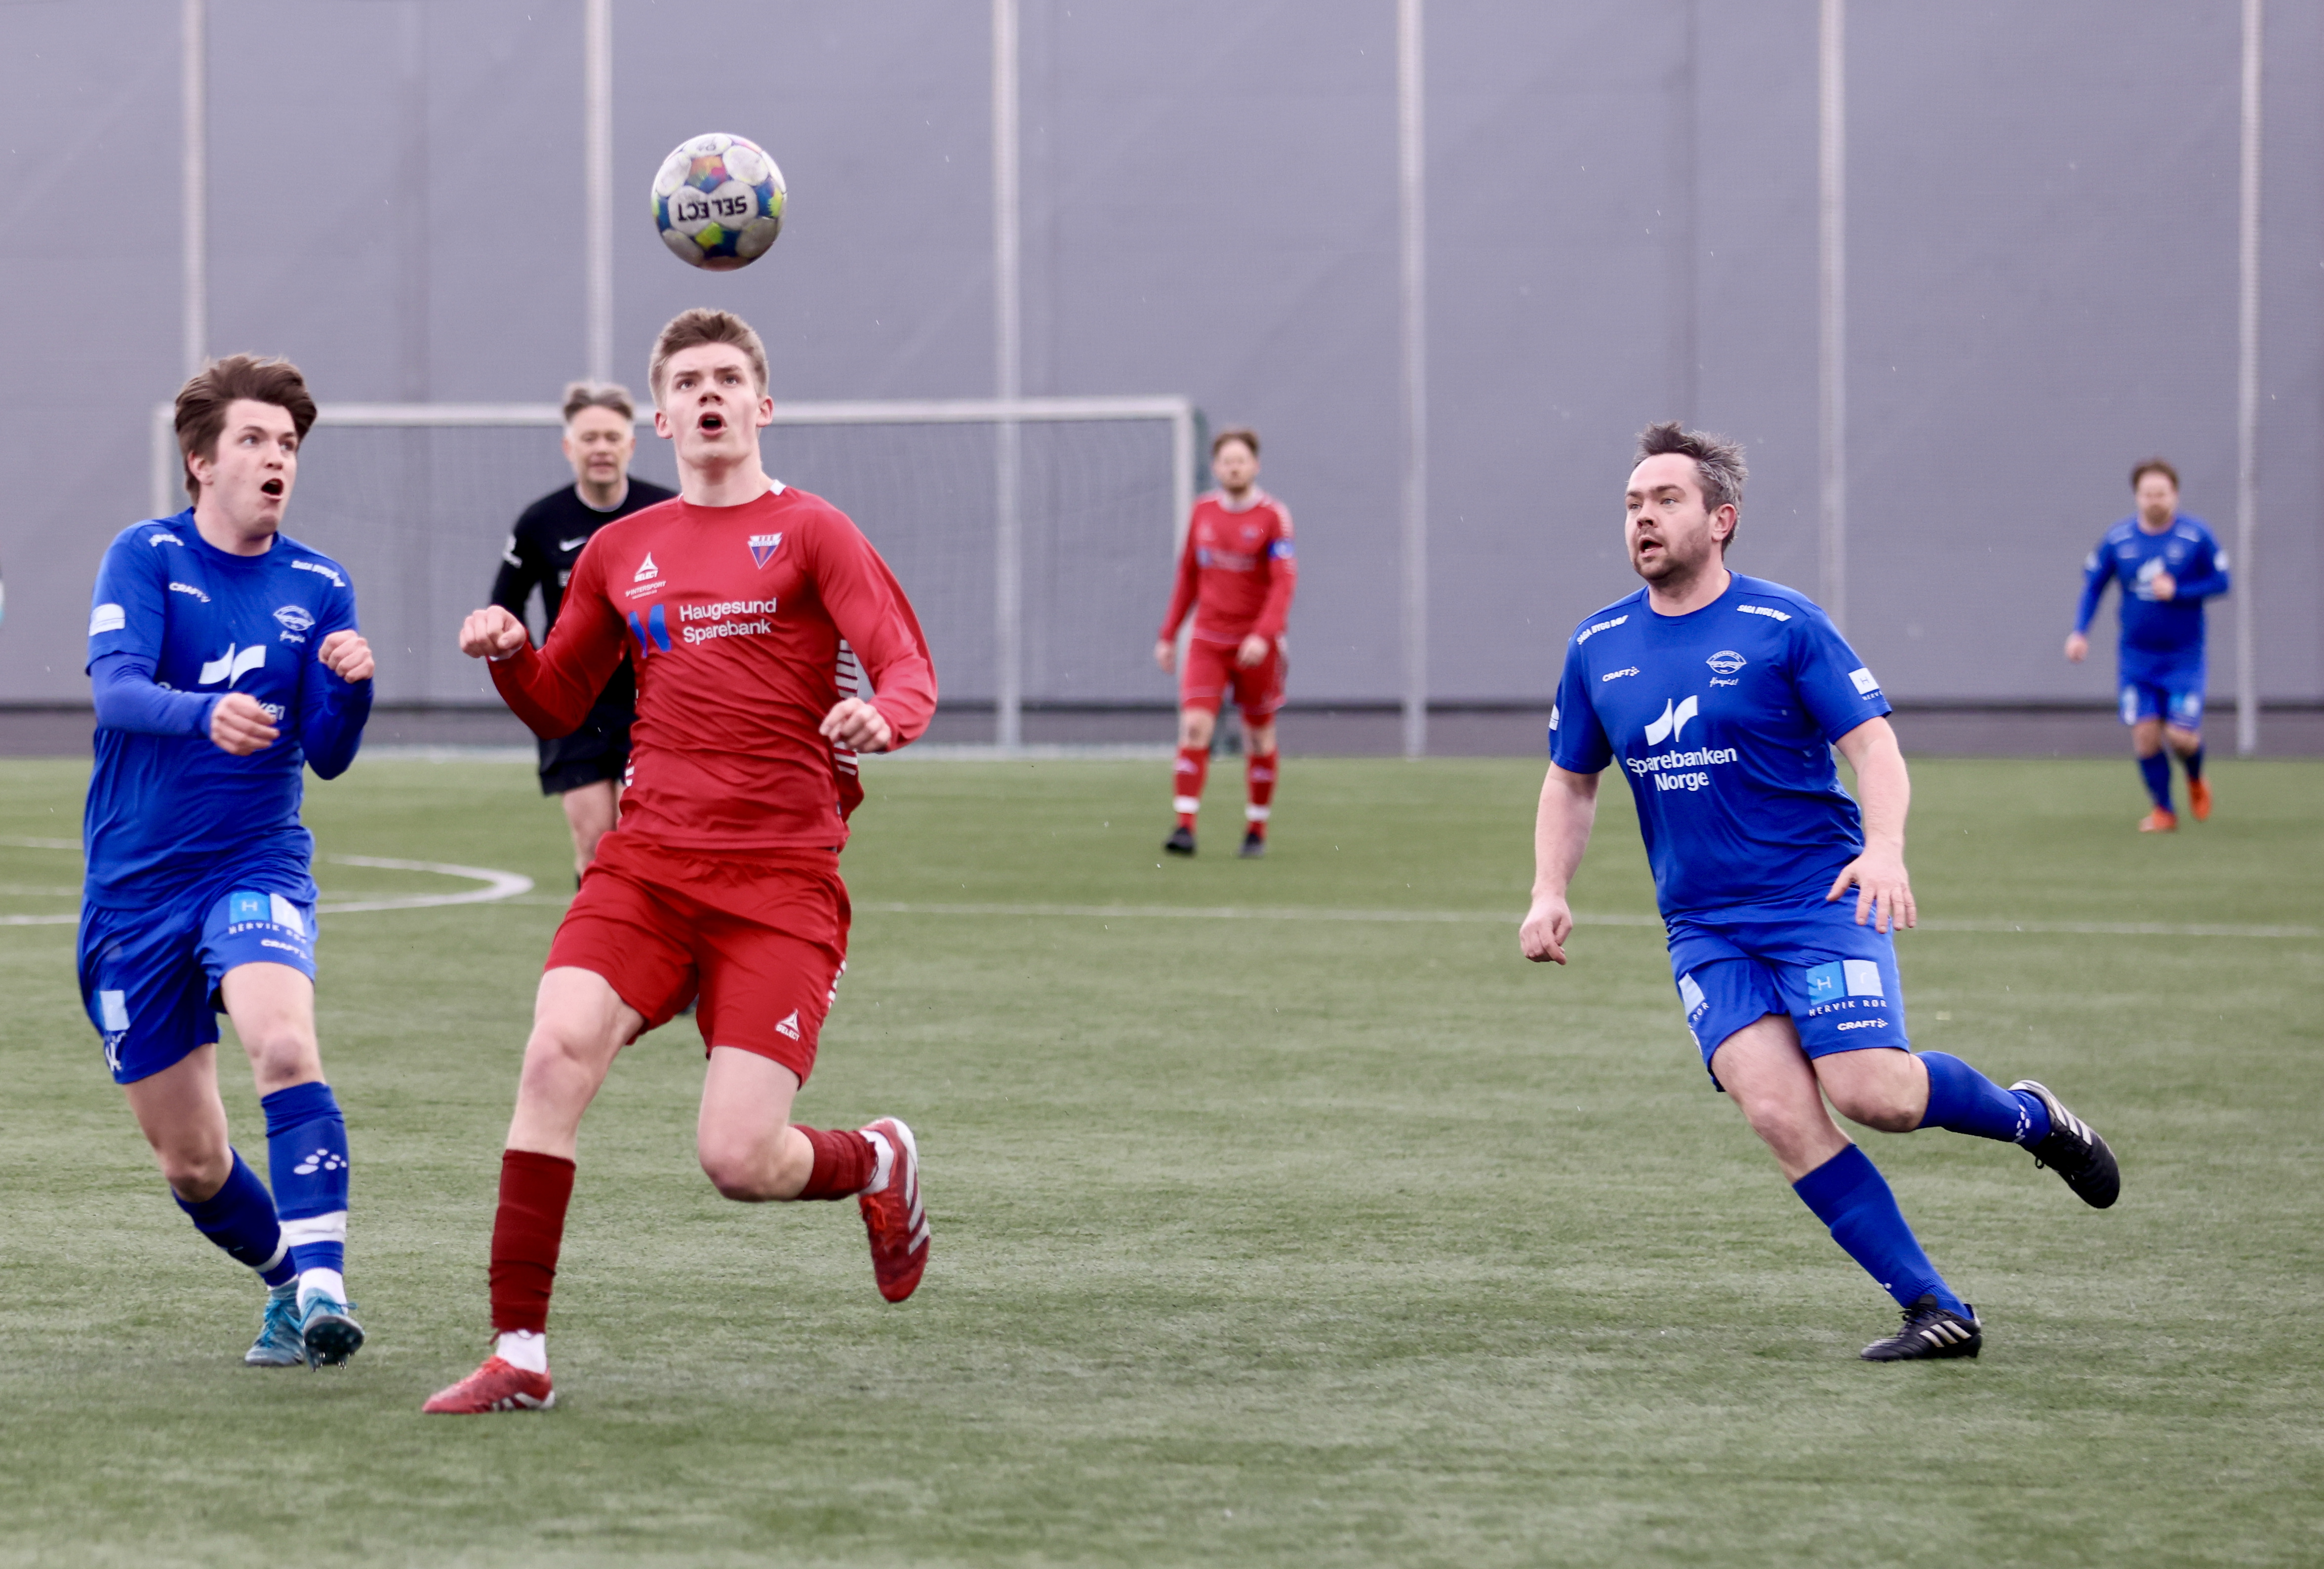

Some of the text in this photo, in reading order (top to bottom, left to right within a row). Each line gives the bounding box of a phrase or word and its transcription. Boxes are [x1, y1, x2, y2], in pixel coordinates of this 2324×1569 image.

[678, 196, 747, 221] SELECT
[634, 570, 658, 583] SELECT
[631, 581, 667, 595] INTERSPORT
[679, 597, 777, 622] Haugesund
[682, 618, 772, 646] Sparebank
[1577, 628, 1593, 645] SAGA
[1602, 668, 1631, 682] CRAFT
[1626, 746, 1738, 778] Sparebanken
[1653, 771, 1710, 791] Norge
[1817, 976, 1832, 991] H
[1808, 1000, 1856, 1017] HERVIK
[775, 1024, 801, 1042] SELECT
[1837, 1020, 1878, 1031] CRAFT
